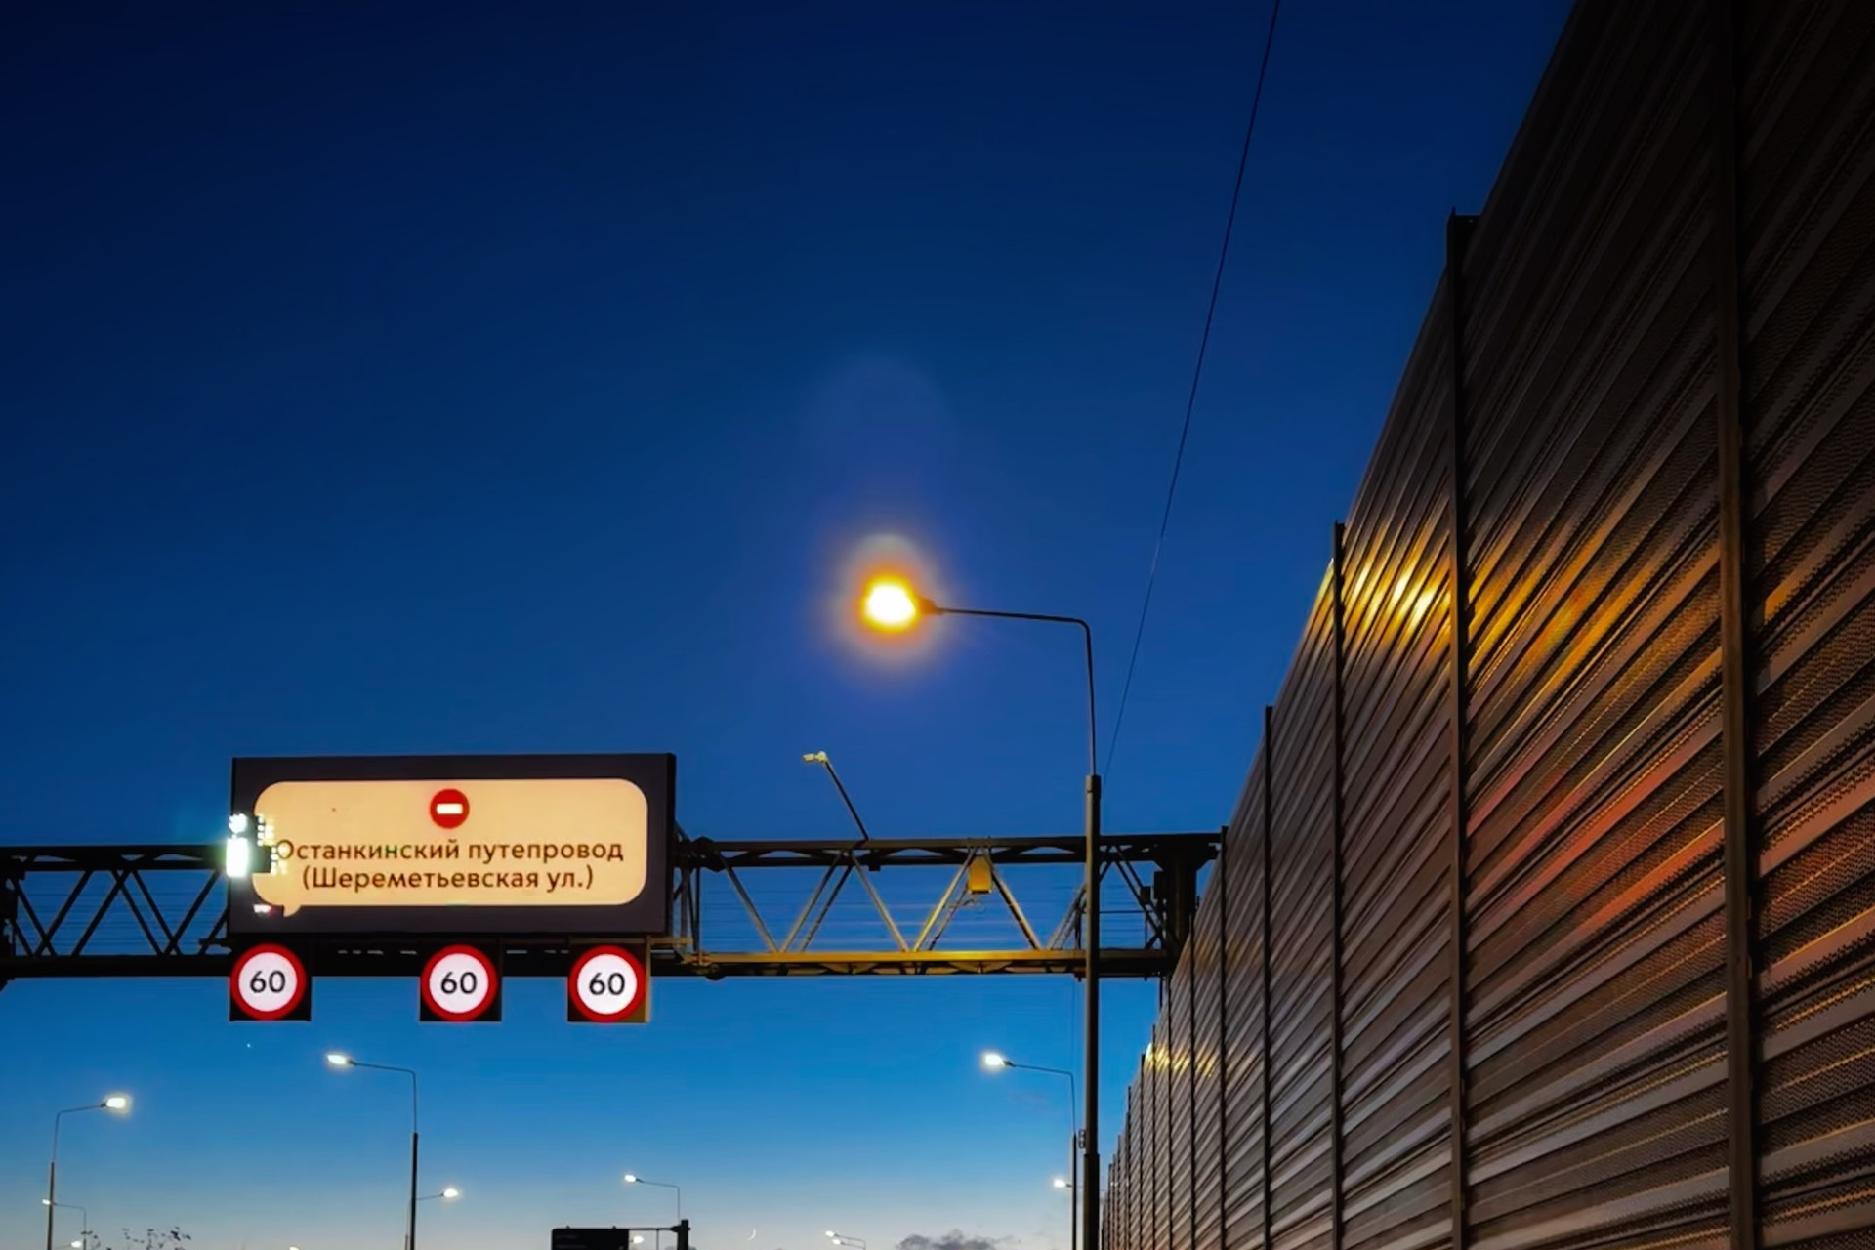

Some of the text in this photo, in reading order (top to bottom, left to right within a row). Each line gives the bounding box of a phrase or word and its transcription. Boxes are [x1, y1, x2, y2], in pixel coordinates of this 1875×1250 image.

[276, 838, 624, 862] Останкинский путепровод
[302, 866, 594, 893] (Шереметьевская ул.)
[249, 970, 286, 994] 60
[440, 971, 477, 995] 60
[588, 972, 625, 996] 60
